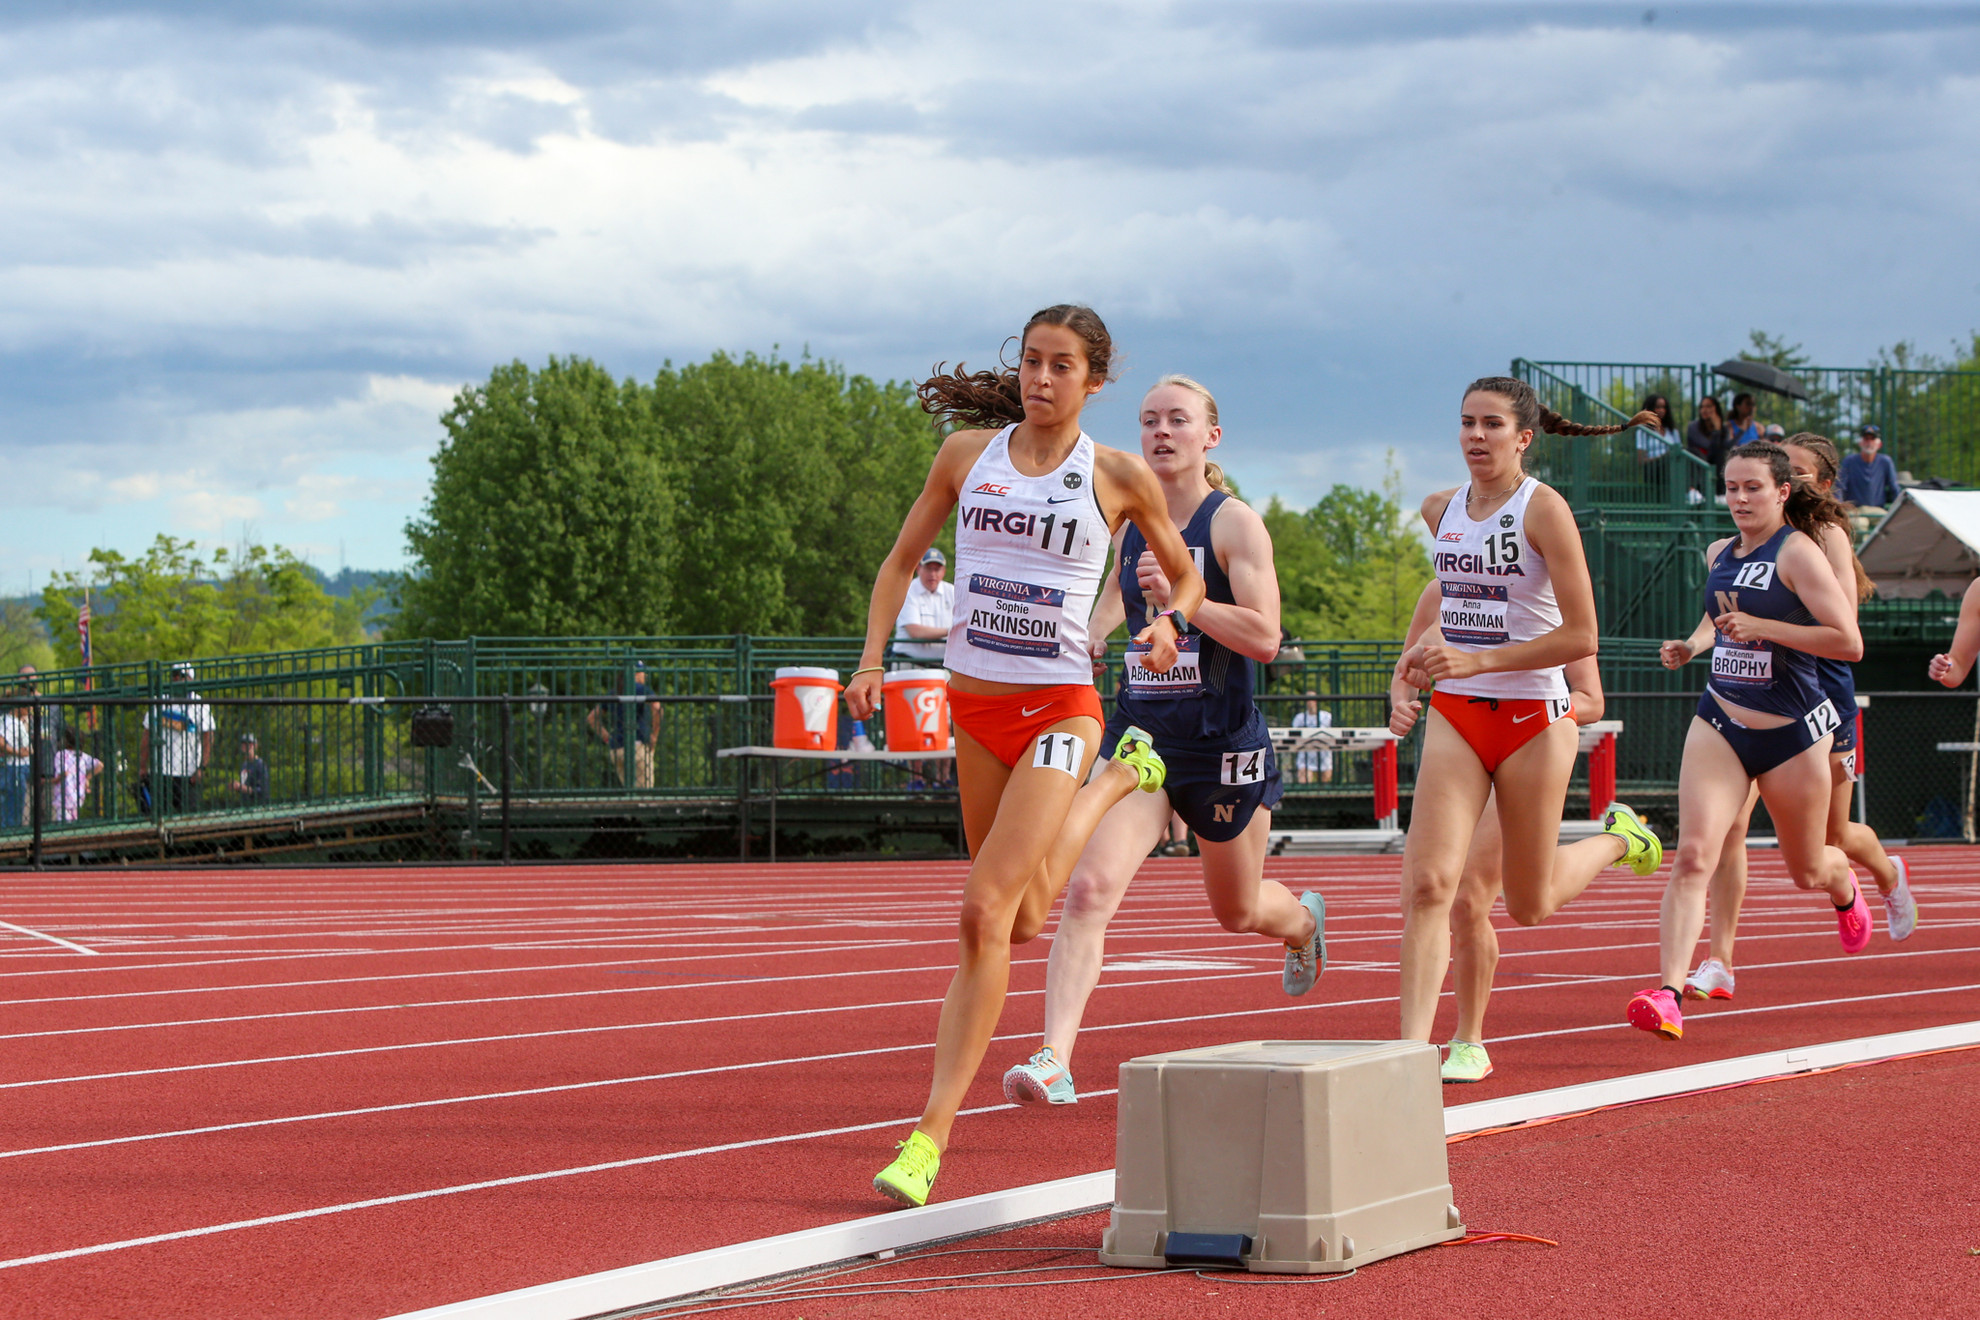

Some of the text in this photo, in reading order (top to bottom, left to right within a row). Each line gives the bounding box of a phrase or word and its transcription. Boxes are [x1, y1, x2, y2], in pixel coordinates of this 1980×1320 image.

[975, 482, 1012, 495] ACC
[961, 505, 1037, 537] VIRGI
[1040, 513, 1077, 555] 11
[1441, 532, 1464, 541] ACC
[1485, 531, 1519, 565] 15
[1737, 562, 1769, 588] 12
[978, 576, 1030, 596] VIRGINIA
[980, 588, 999, 597] TRACK
[1008, 593, 1027, 601] FIELD
[1445, 582, 1483, 594] VIRGINIA
[996, 599, 1029, 614] Sophie
[1462, 599, 1481, 609] Anna
[970, 609, 1057, 639] ATKINSON
[1441, 610, 1504, 629] WORKMAN
[1725, 649, 1755, 659] McKenna
[1131, 665, 1197, 682] ABRAHAM
[1714, 657, 1768, 676] BROPHY
[917, 690, 937, 712] G
[1809, 704, 1837, 737] 12
[1039, 734, 1076, 772] 11
[1225, 753, 1259, 784] 14
[1213, 804, 1234, 823] N
